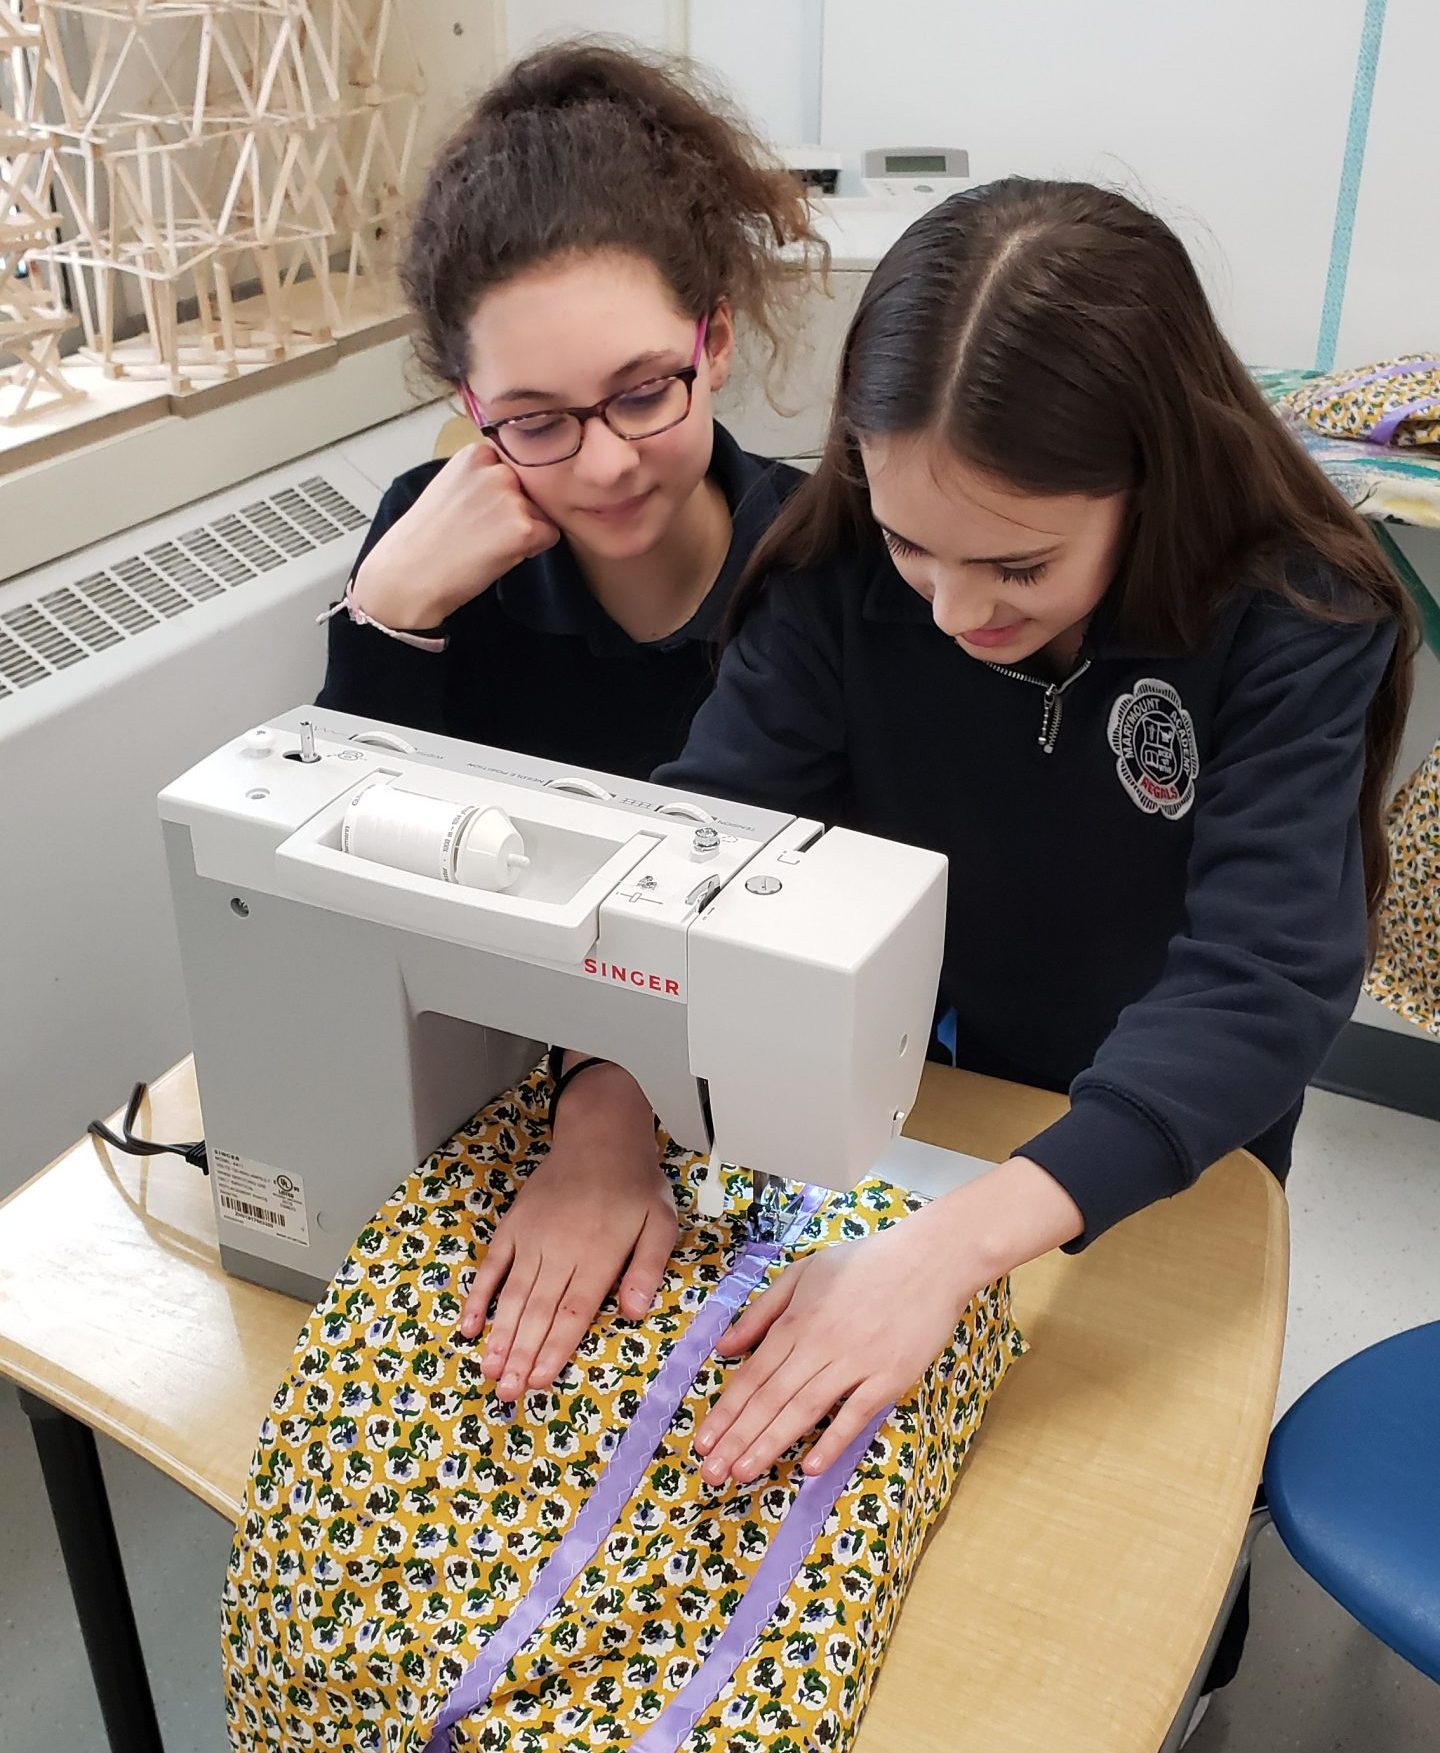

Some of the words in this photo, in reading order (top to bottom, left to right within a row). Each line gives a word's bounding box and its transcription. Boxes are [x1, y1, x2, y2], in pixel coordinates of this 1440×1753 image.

[1121, 697, 1161, 759] MARYMOUNT
[1170, 711, 1191, 777] ACADEMY
[1140, 778, 1179, 799] REGALS
[583, 957, 680, 997] SINGER
[214, 1149, 240, 1161] SINGER
